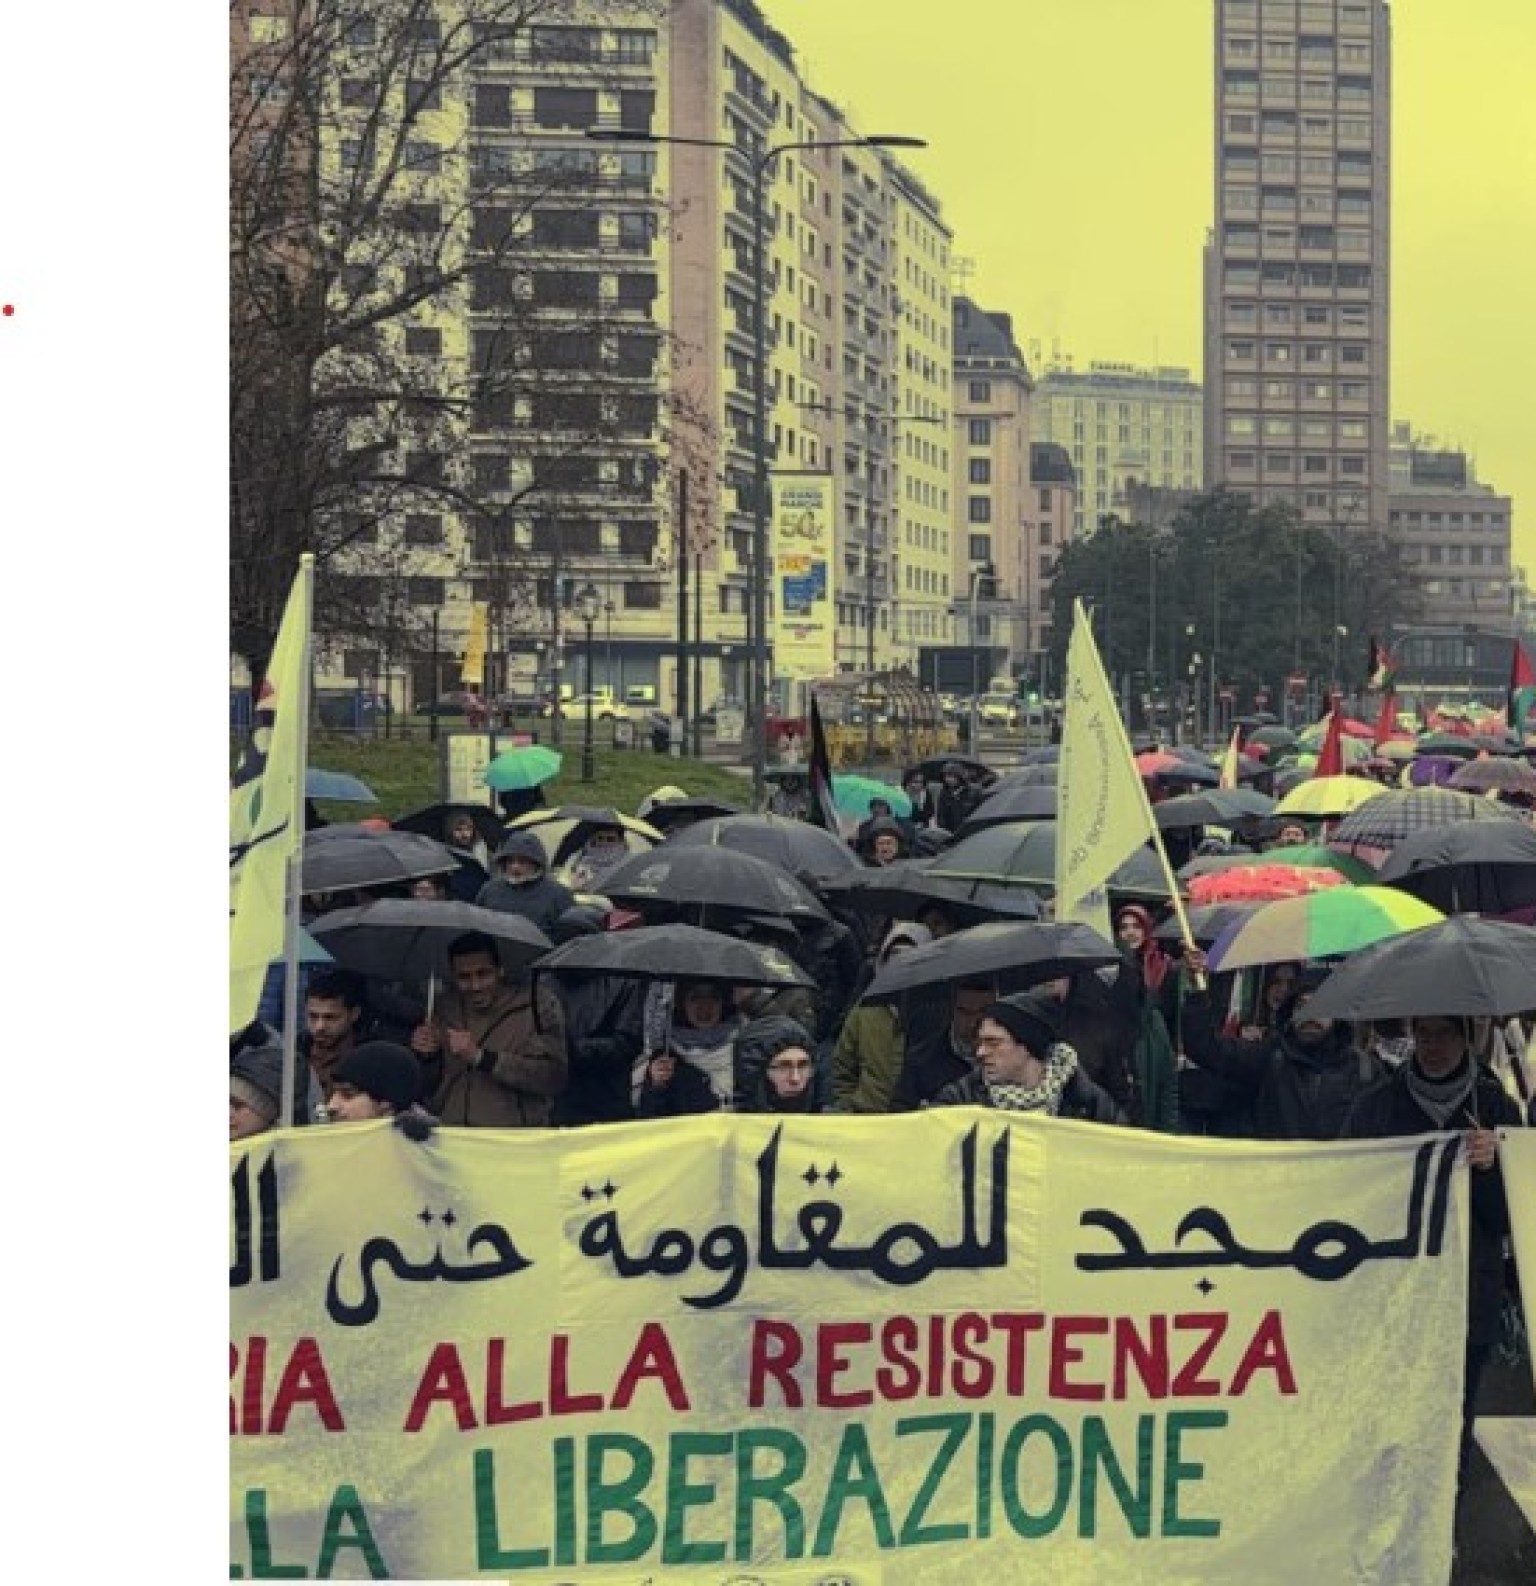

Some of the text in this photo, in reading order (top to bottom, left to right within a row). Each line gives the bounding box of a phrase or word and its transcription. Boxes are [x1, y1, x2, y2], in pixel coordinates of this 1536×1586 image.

[325, 1208, 534, 1327] حتى
[579, 1122, 1010, 1309] للمقاومة
[1075, 1134, 1462, 1297] المجد
[403, 1323, 689, 1432] ALLA
[750, 1309, 1298, 1408] RESISTENZA
[473, 1408, 1230, 1571] LIBERAZIONE
